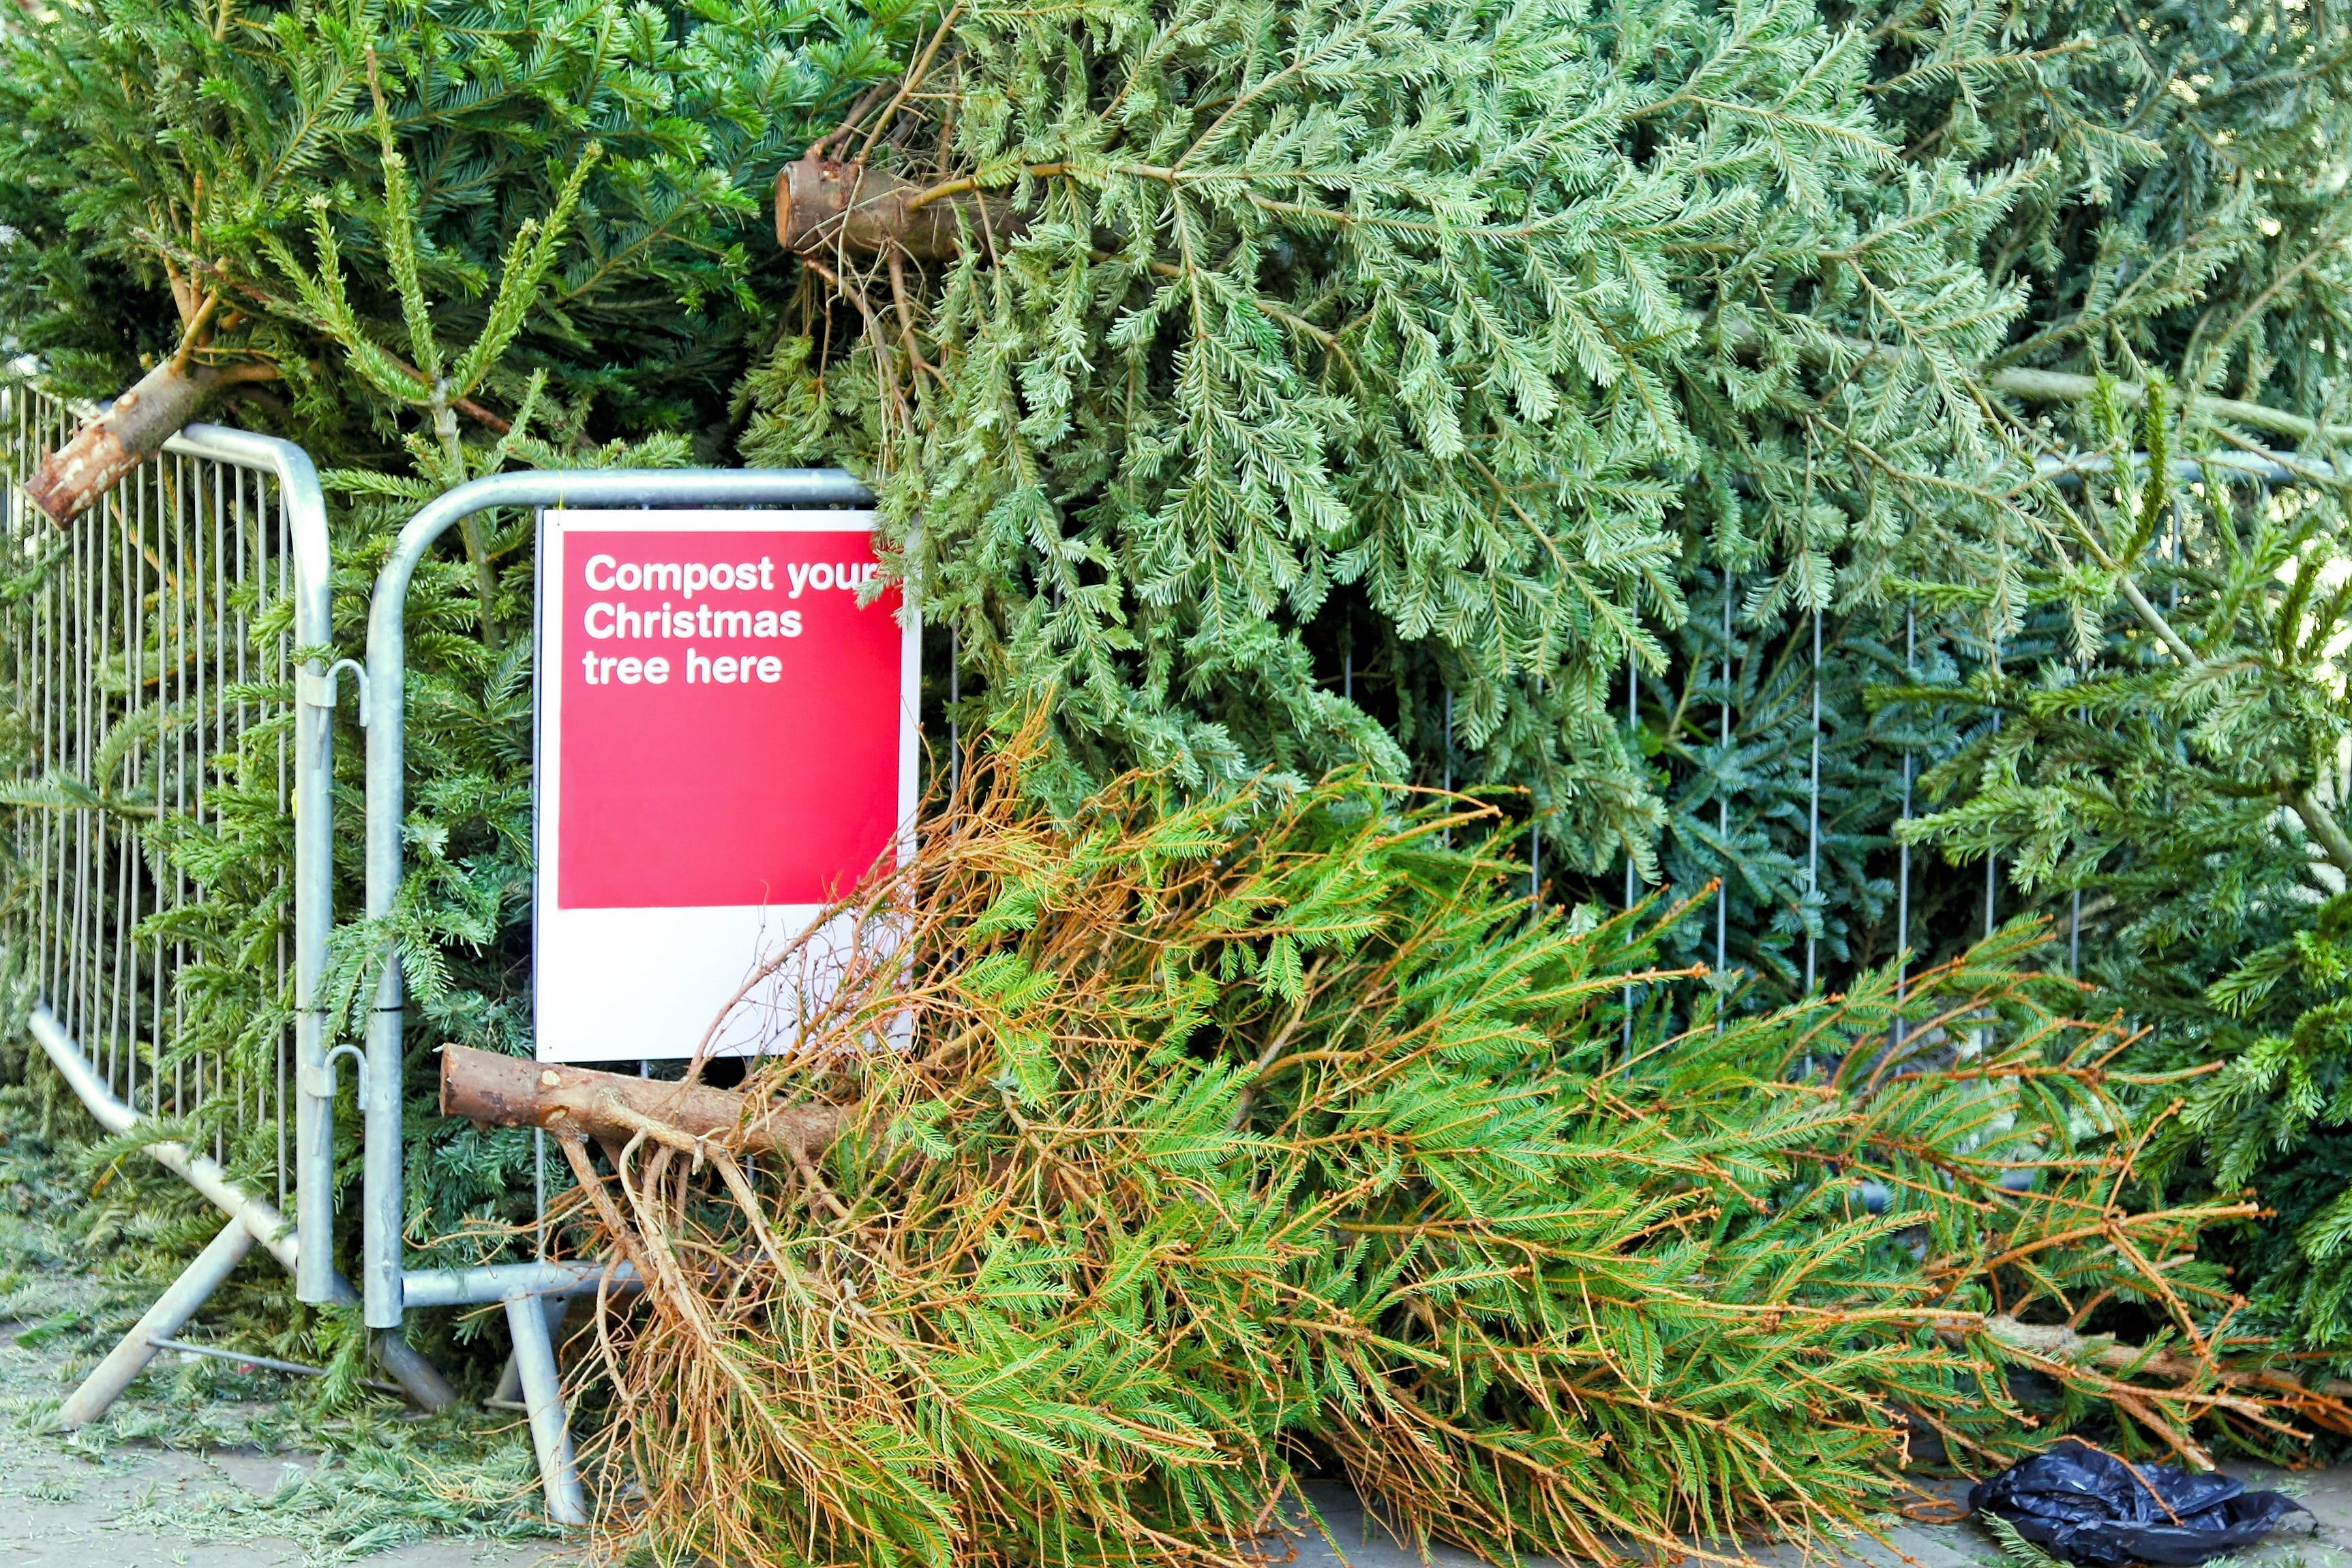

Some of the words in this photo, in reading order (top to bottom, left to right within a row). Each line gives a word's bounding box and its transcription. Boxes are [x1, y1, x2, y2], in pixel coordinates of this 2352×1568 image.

[584, 554, 775, 599] Compost
[786, 562, 878, 599] your
[584, 601, 802, 639] Christmas
[582, 650, 670, 685] tree
[686, 647, 783, 684] here
